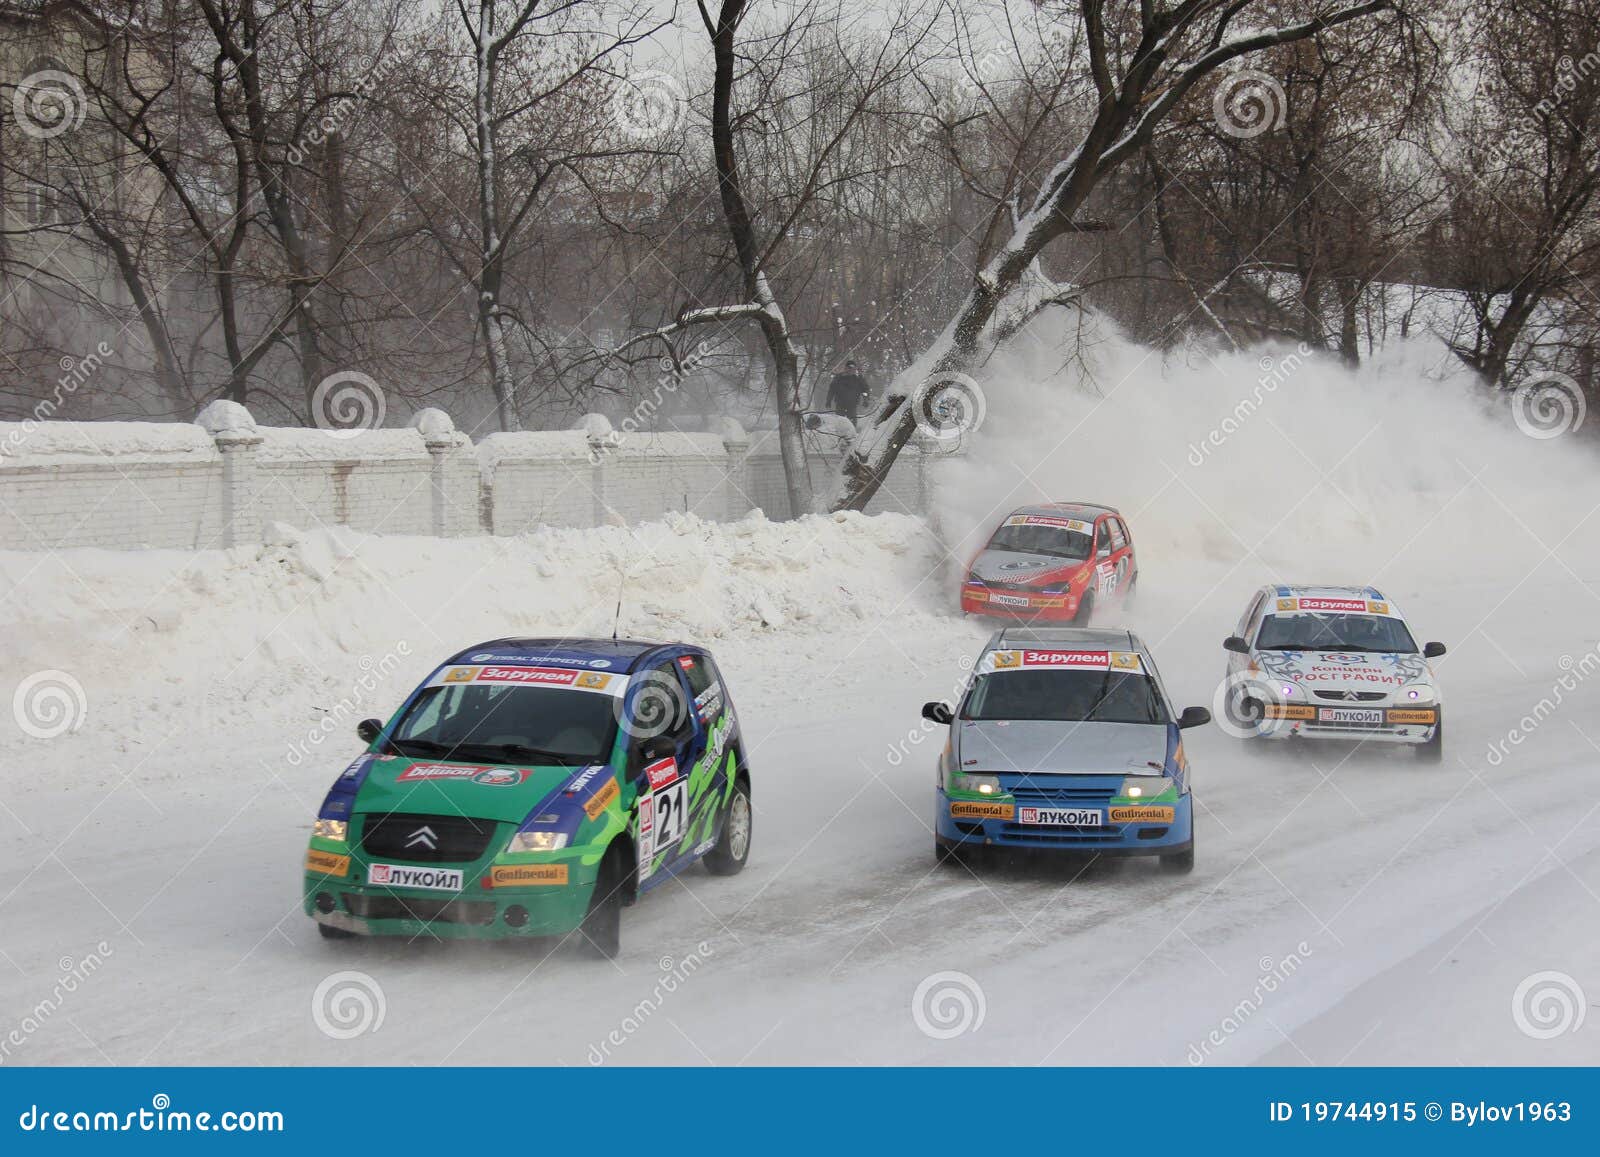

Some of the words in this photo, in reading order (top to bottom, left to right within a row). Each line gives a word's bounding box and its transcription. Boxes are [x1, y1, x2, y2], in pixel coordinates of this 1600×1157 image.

[1334, 709, 1380, 722] ЛУКОЙЛ
[657, 785, 683, 846] 21
[951, 803, 1003, 815] Continental
[1111, 809, 1165, 821] Continental
[1038, 809, 1099, 825] ЛУКОЙЛ
[390, 869, 459, 889] ЛУКОЙЛ
[494, 868, 558, 883] Continental
